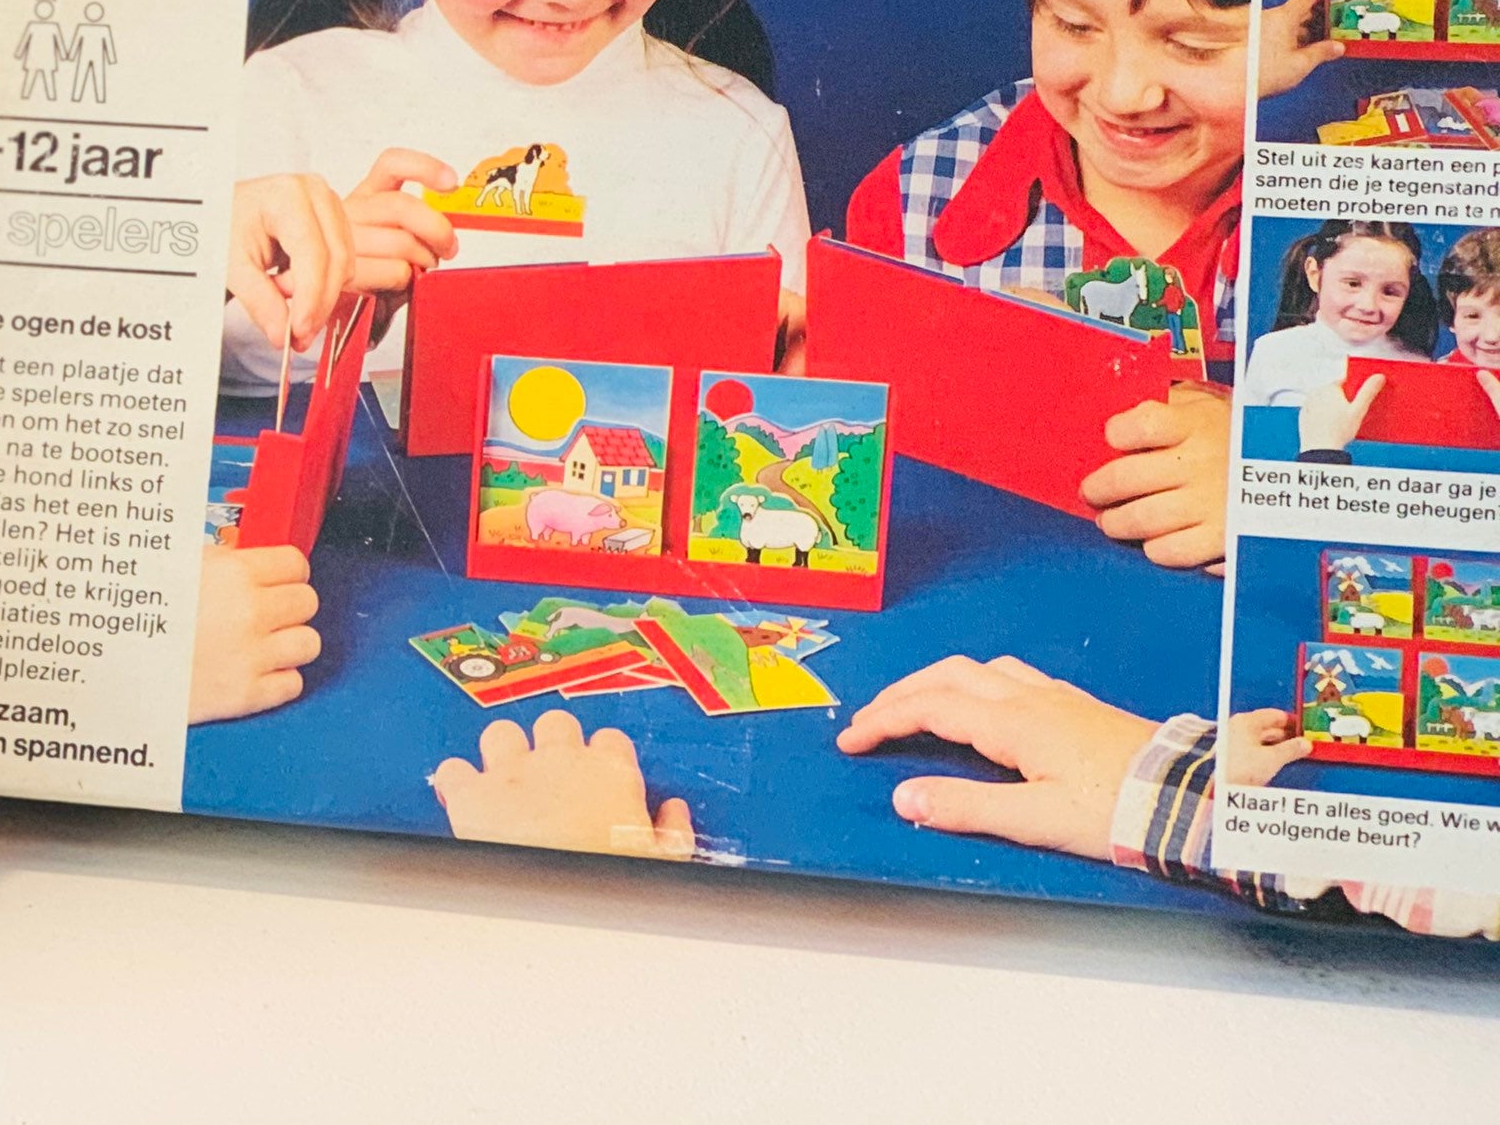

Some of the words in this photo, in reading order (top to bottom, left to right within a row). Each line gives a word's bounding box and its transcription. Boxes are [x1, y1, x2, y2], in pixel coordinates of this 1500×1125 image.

[64, 132, 163, 185] jaar
[1257, 148, 1295, 166] Stel
[1302, 151, 1327, 167] uit
[1333, 156, 1364, 169] zes
[1371, 153, 1444, 172] kaarten
[1451, 161, 1486, 173] een
[1256, 175, 1322, 189] samen
[1329, 174, 1359, 191] die
[1364, 175, 1382, 195] je
[1388, 179, 1499, 197] tegenstand
[1255, 197, 1330, 211] moeten
[1337, 198, 1428, 216] proberen
[1435, 205, 1459, 217] na
[1465, 204, 1483, 218] te
[7, 206, 199, 257] spelers
[11, 315, 75, 337] ogen
[80, 315, 112, 337] de
[117, 317, 172, 341] kost
[13, 360, 54, 376] een
[62, 360, 139, 386] plaatje
[147, 365, 183, 385] dat
[12, 385, 93, 407] spelers
[100, 394, 186, 412] moeten
[22, 416, 58, 431] om
[66, 413, 102, 435] het
[107, 422, 132, 437] zo
[138, 421, 184, 440] snel
[7, 442, 33, 457] na
[42, 442, 62, 459] te
[71, 441, 168, 467] bootsen.
[14, 464, 72, 487] hond
[81, 469, 132, 492] links
[140, 474, 165, 494] of
[1242, 465, 1291, 484] Even
[1298, 469, 1360, 492] kijken,
[1367, 478, 1391, 491] en
[1397, 477, 1443, 494] daar
[1448, 483, 1472, 499] ga
[1479, 481, 1496, 501] je
[34, 494, 70, 515] het
[77, 502, 117, 518] een
[127, 500, 173, 523] huis
[1241, 488, 1292, 507] heeft
[1298, 492, 1330, 510] het
[1336, 495, 1390, 514] beste
[1396, 500, 1500, 523] geheugen
[56, 523, 95, 545] Het
[103, 526, 120, 547] is
[129, 529, 171, 550] niet
[56, 556, 92, 572] om
[102, 554, 137, 576] het
[55, 581, 76, 599] te
[85, 580, 168, 608] krijgen.
[69, 612, 167, 638] mogelijk
[13, 738, 154, 768] spannend.
[1227, 792, 1286, 813] Klaar!
[1294, 798, 1319, 816] En
[1326, 802, 1371, 821] alles
[1378, 810, 1433, 827] goed.
[1441, 811, 1480, 831] Wie
[1225, 815, 1250, 833] de
[1257, 820, 1350, 842] volgende
[1357, 827, 1421, 848] beurt?
